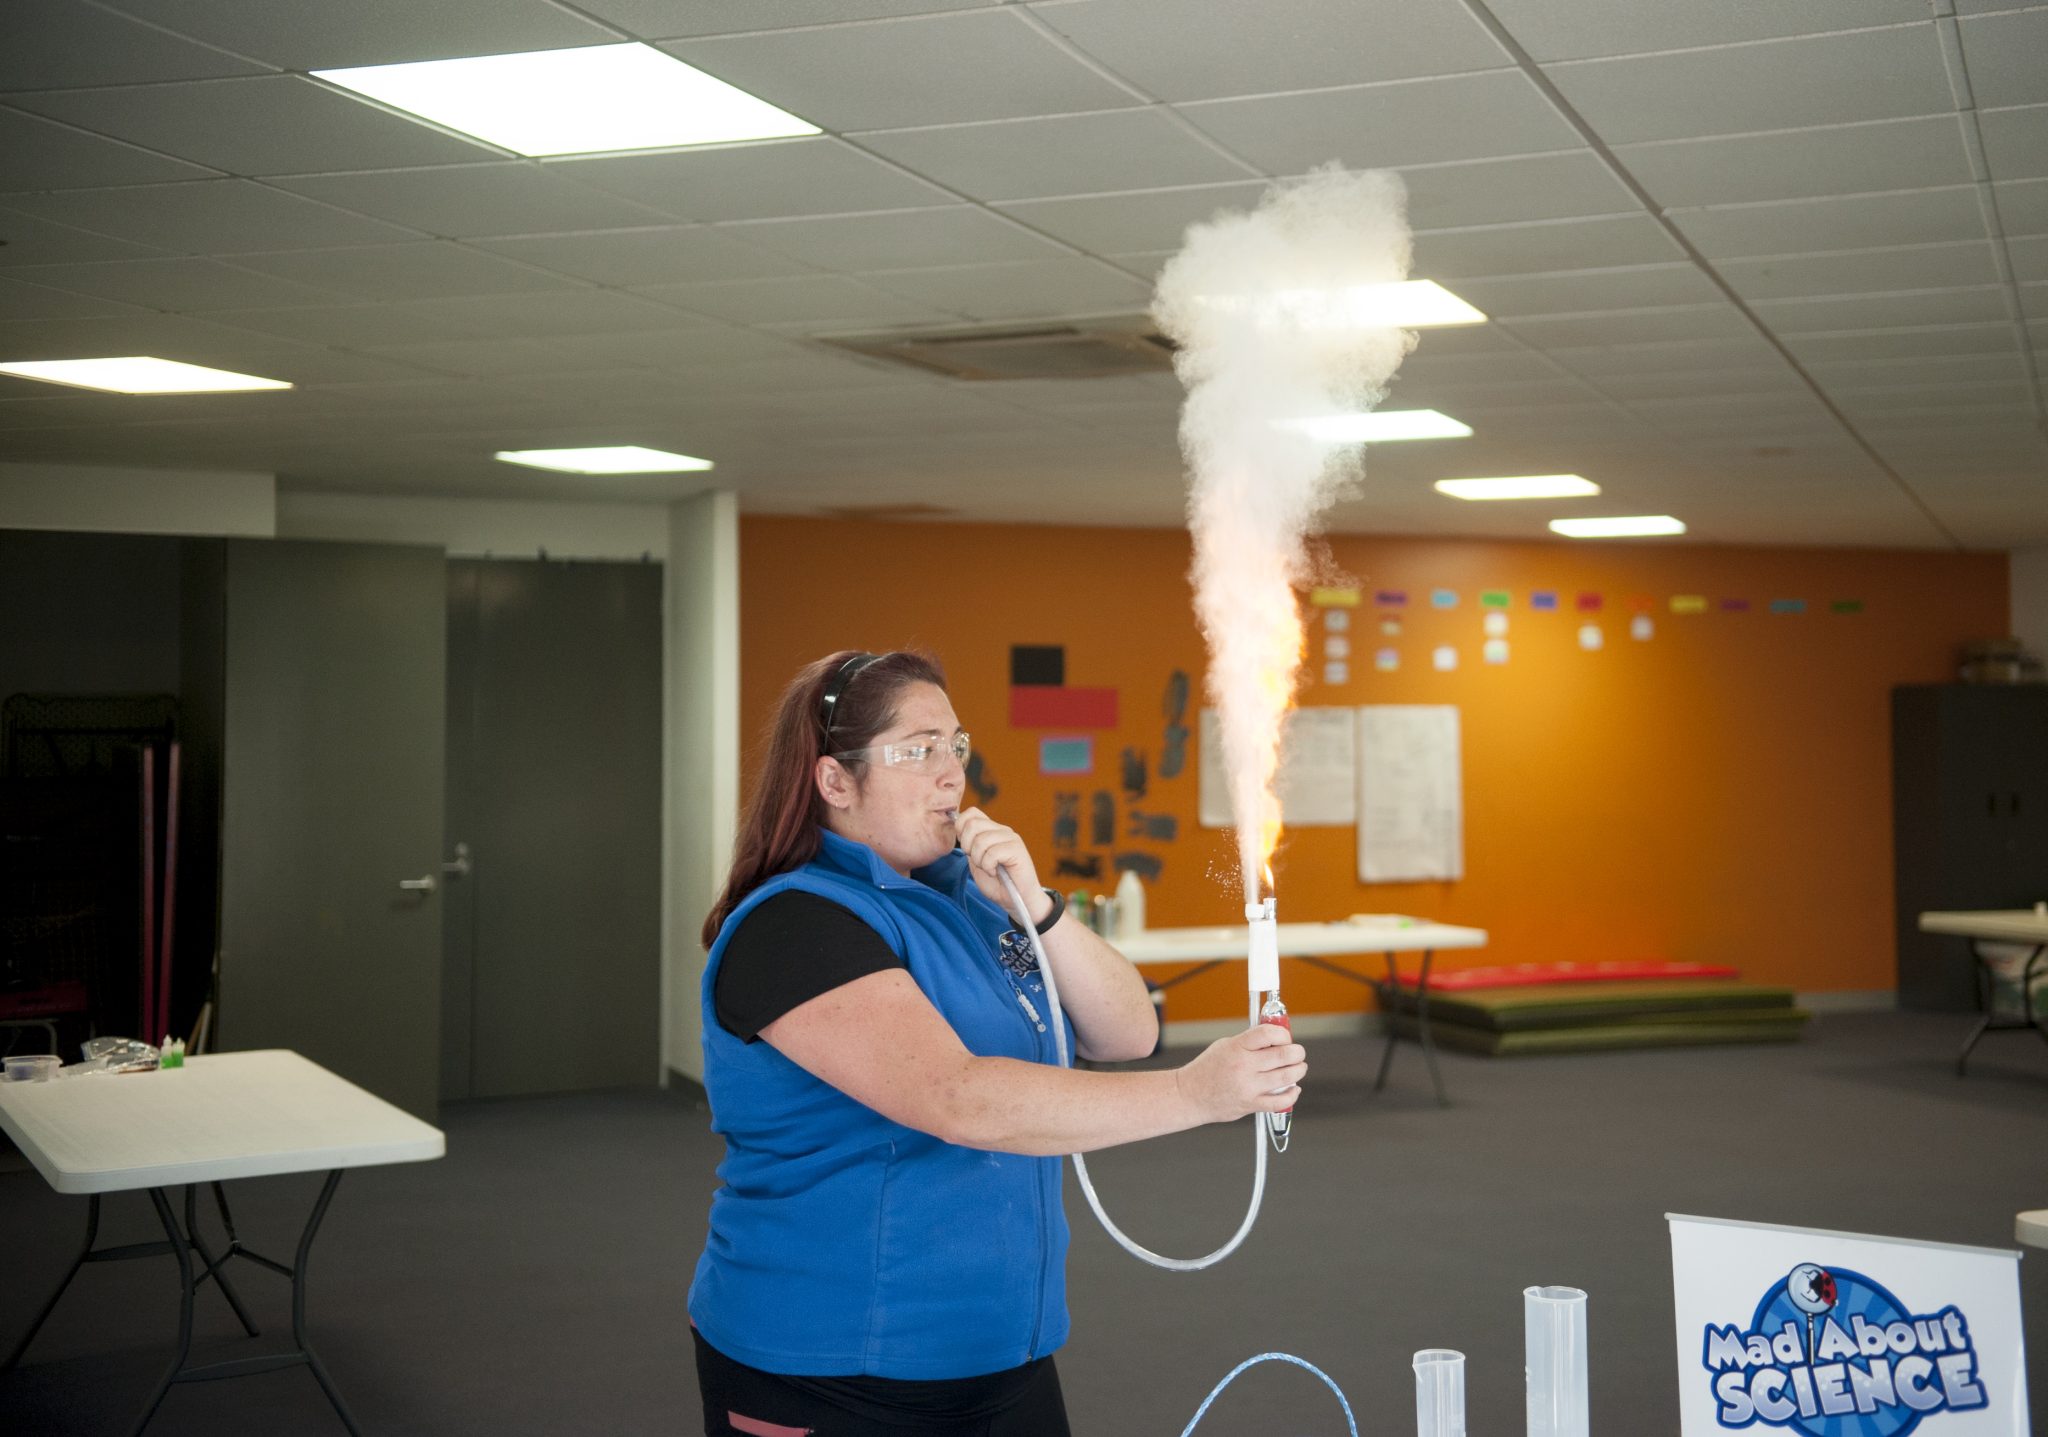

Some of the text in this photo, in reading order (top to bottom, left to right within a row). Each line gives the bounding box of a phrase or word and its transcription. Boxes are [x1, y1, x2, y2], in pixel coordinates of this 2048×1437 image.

[1011, 944, 1036, 976] SCIEN
[1708, 1311, 1968, 1370] Mad About
[1716, 1353, 1982, 1423] SCIENCE
